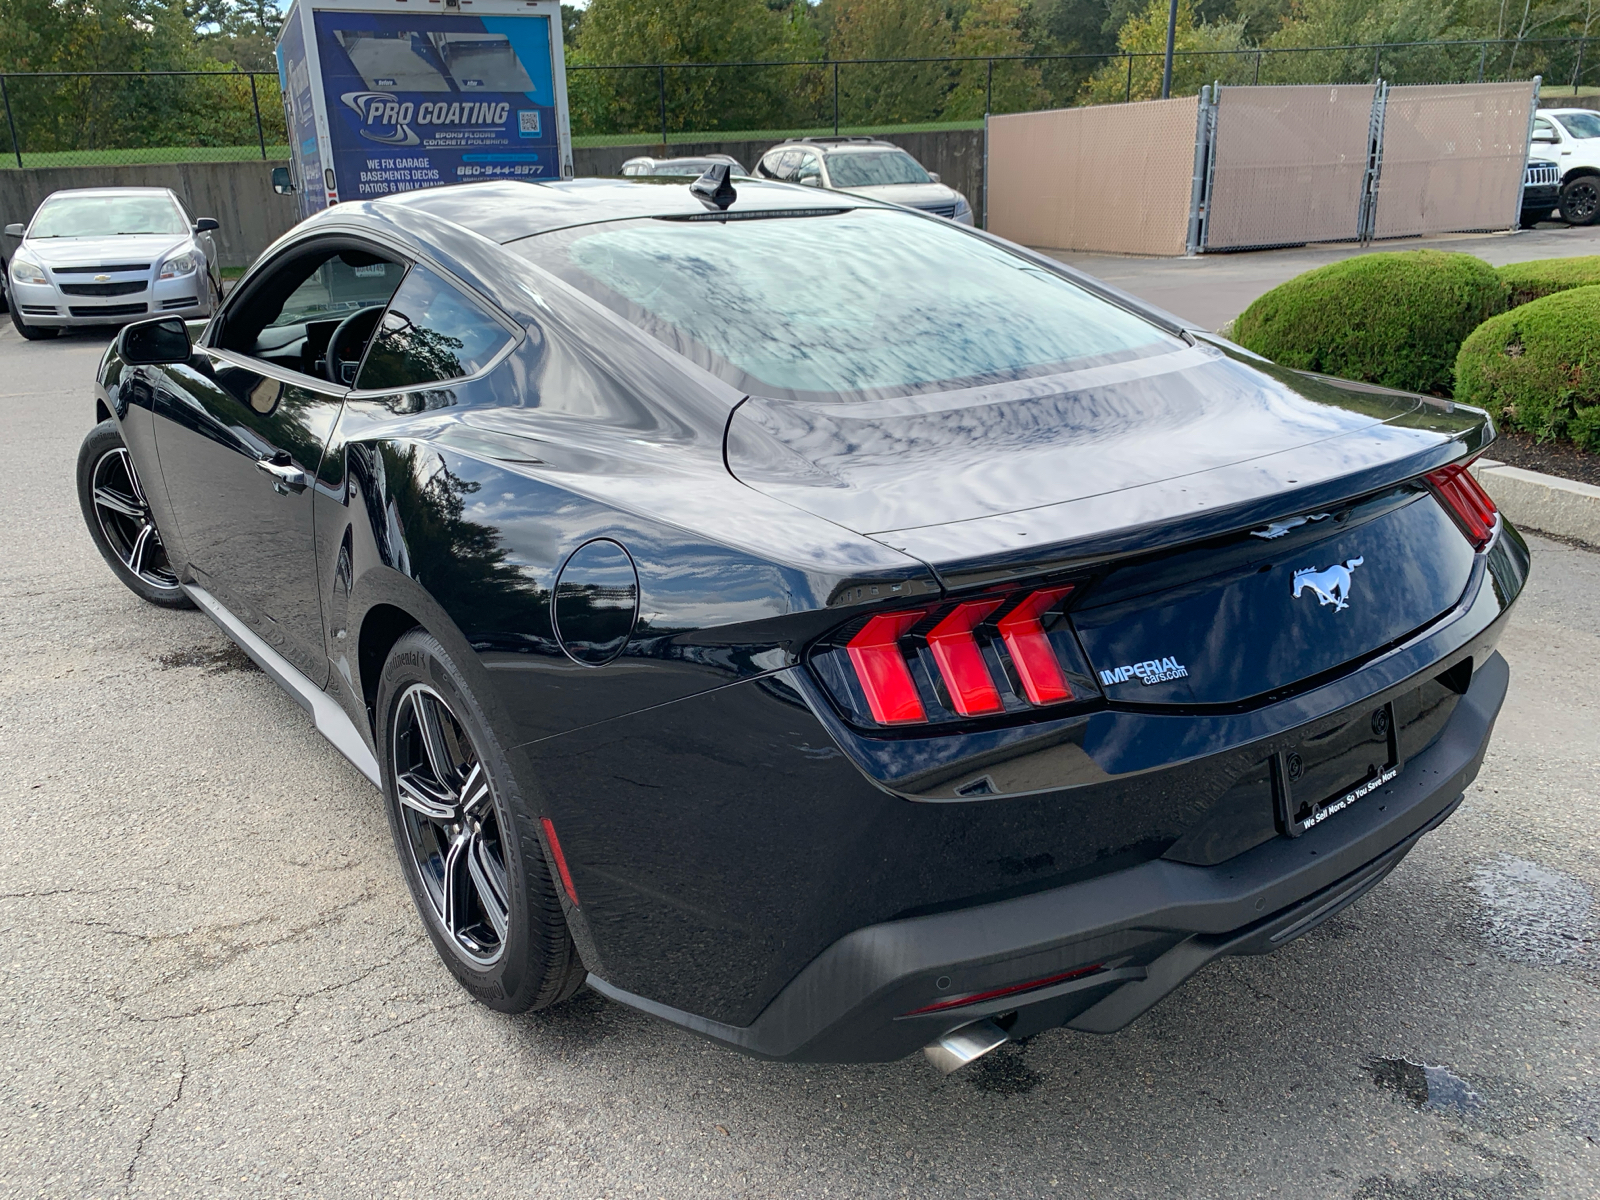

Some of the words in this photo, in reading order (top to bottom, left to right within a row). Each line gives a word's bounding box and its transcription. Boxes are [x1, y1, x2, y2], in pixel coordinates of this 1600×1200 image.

[367, 102, 414, 125] PRO
[417, 102, 510, 125] COATING
[366, 159, 380, 169] WE
[381, 158, 395, 169] FIX
[396, 157, 430, 168] GARAGE
[457, 165, 544, 176] 860-944-9977
[360, 170, 411, 182] BASEMENTS
[412, 169, 439, 180] DECKS
[359, 182, 389, 194] PATIOS
[390, 182, 397, 192] &
[385, 651, 420, 682] Continental
[1100, 656, 1185, 685] IMPERIAL
[1143, 669, 1188, 685] cars.com
[1304, 818, 1316, 829] We
[1315, 810, 1328, 823] Sell
[1328, 801, 1346, 816] More,
[1346, 794, 1355, 805] So
[1355, 787, 1368, 799] You
[1367, 779, 1382, 791] Save
[1382, 769, 1397, 783] More
